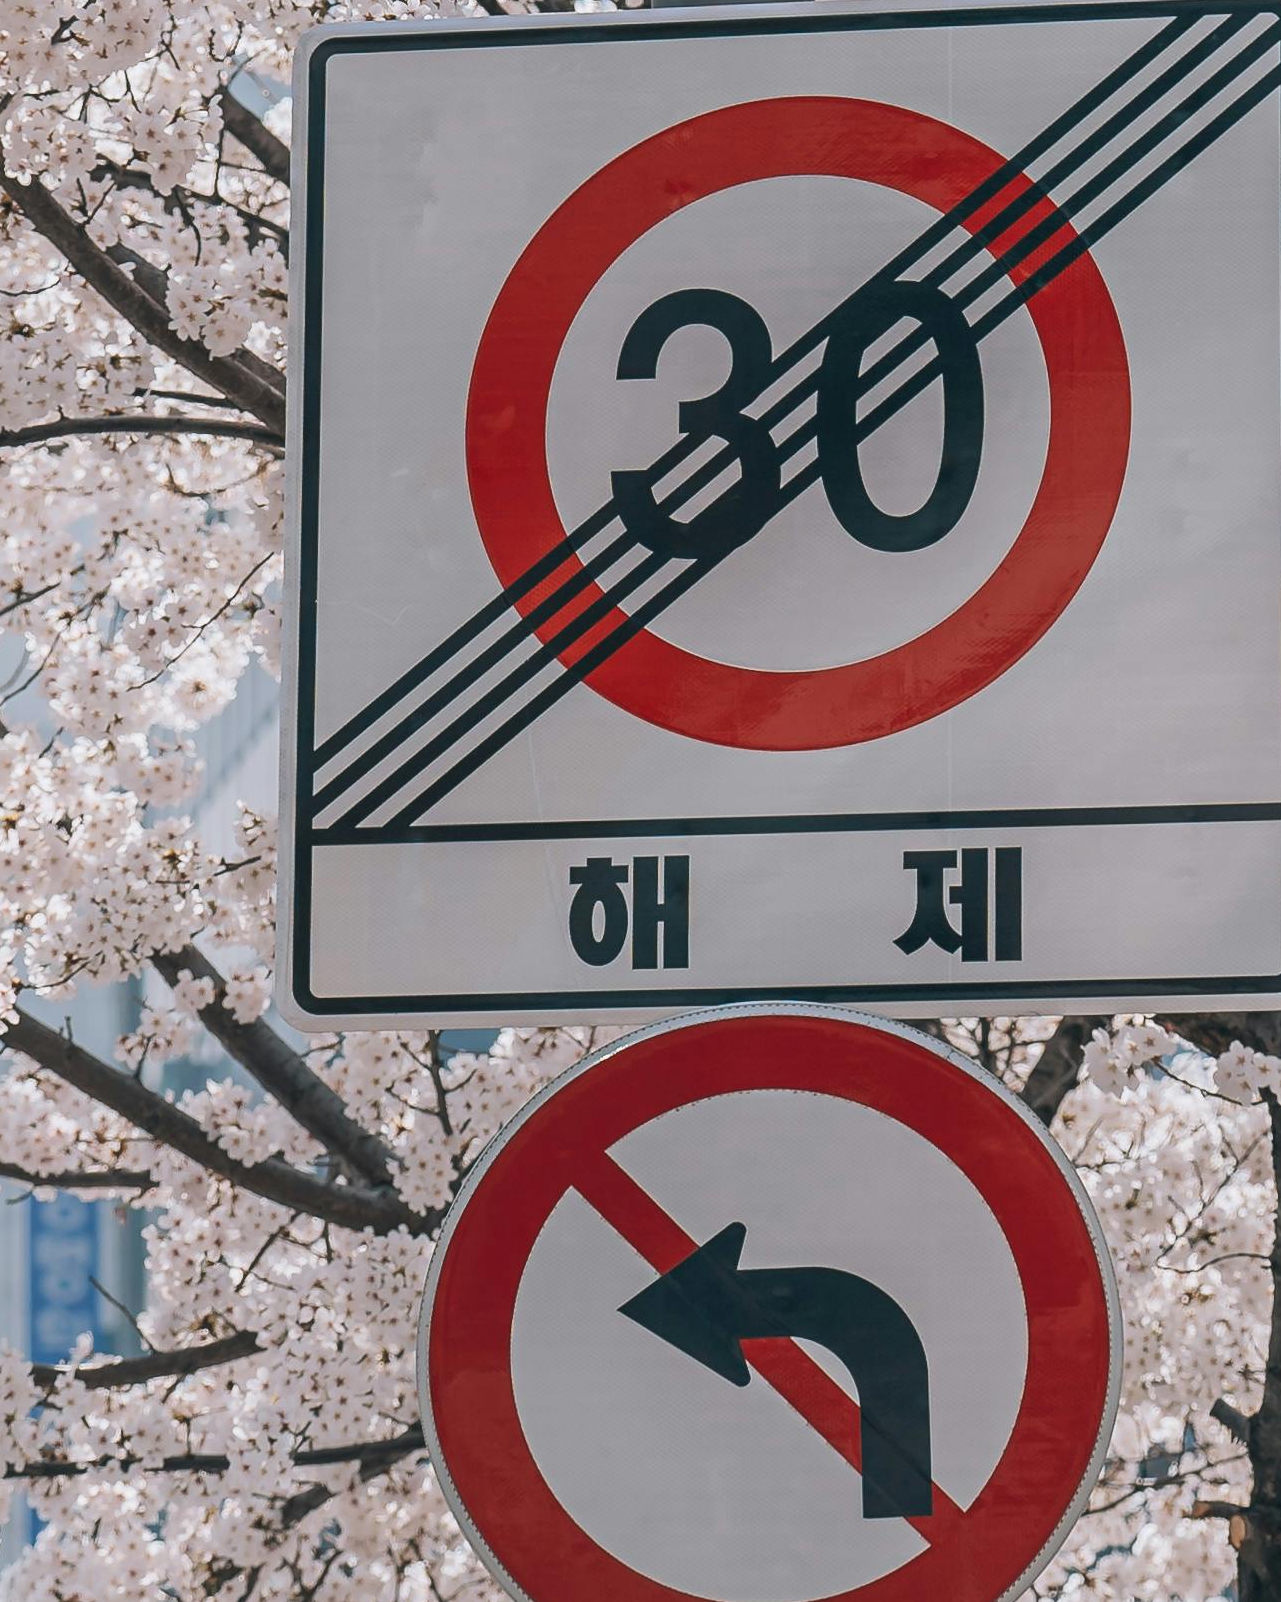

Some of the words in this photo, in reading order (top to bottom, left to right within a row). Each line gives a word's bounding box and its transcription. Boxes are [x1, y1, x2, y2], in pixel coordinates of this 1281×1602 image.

[611, 280, 985, 560] 30
[568, 855, 691, 970] 해
[892, 846, 1023, 963] 제
